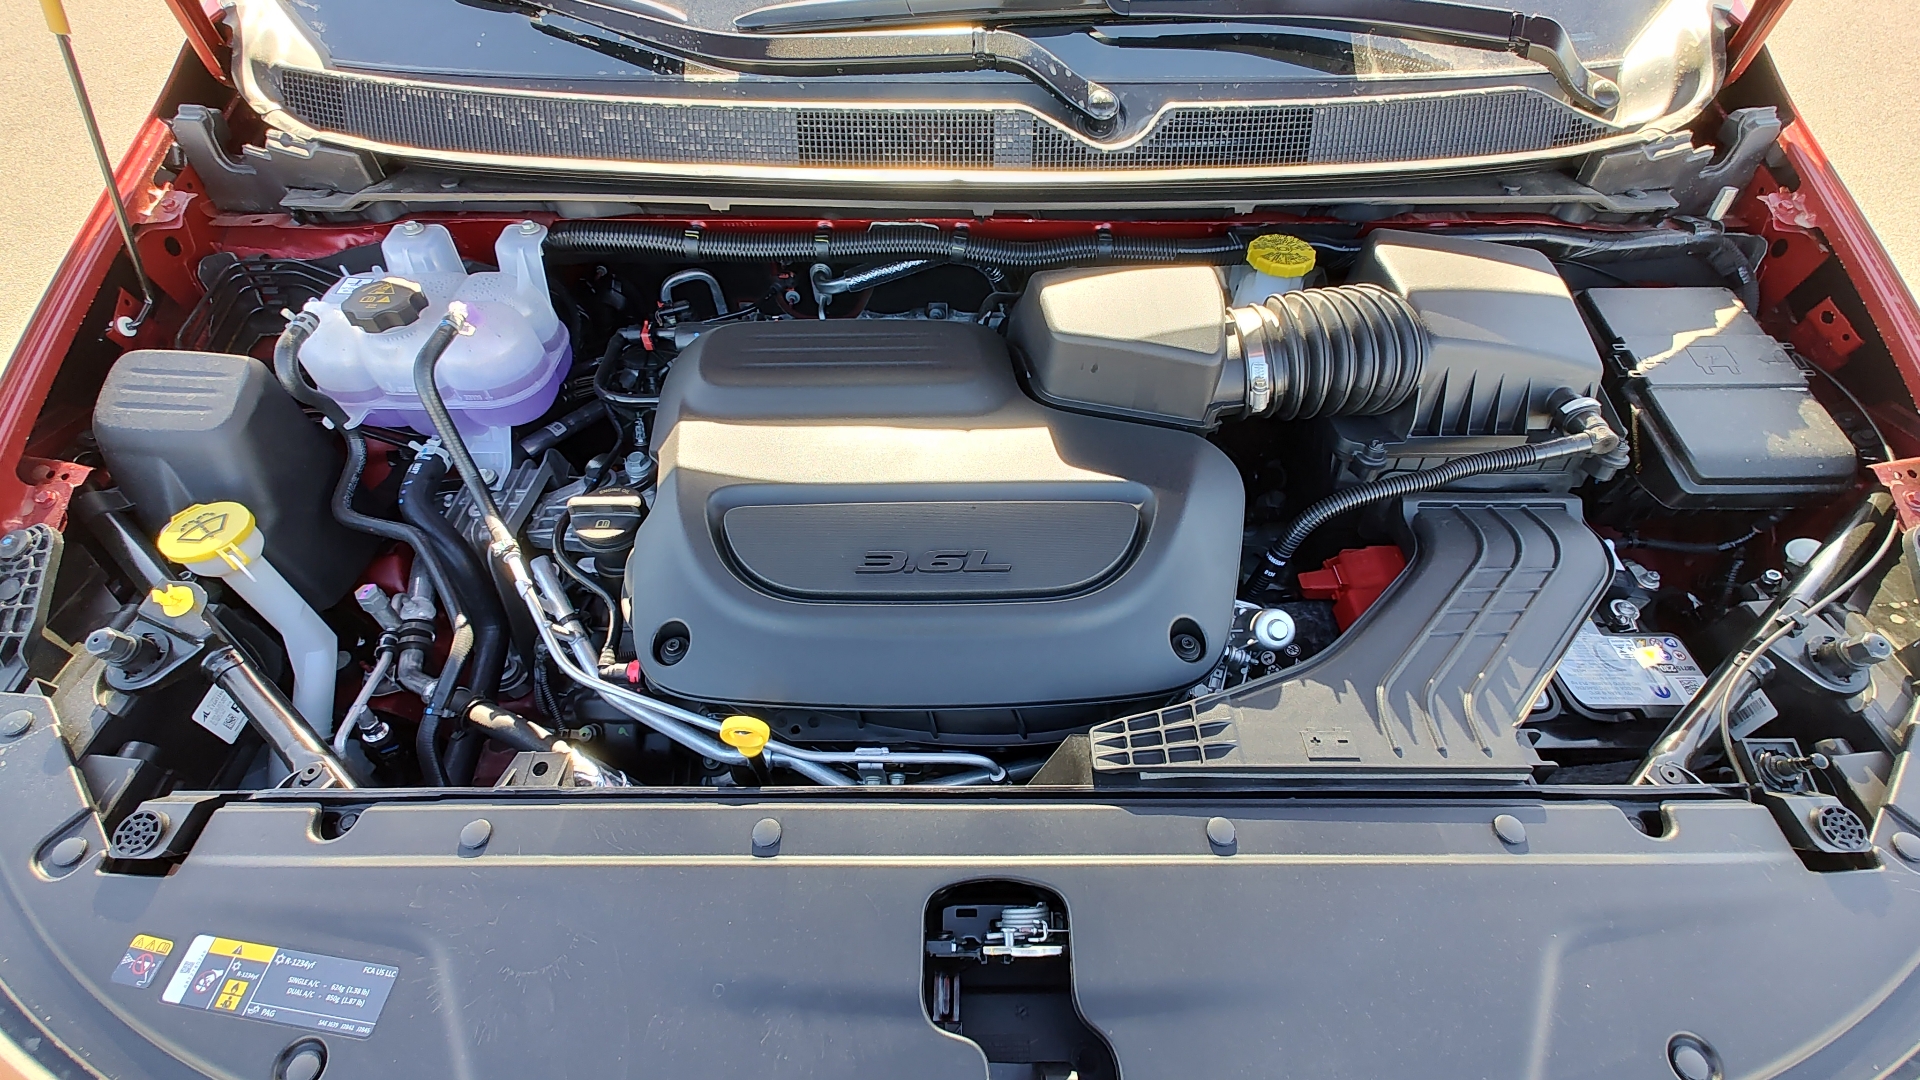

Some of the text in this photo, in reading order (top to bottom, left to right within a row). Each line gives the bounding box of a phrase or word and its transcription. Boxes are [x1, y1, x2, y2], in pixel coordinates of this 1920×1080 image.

[599, 487, 621, 495] ENGINE
[855, 549, 1012, 574] 3.6L
[284, 957, 317, 970] R-1234yf
[236, 970, 260, 980] R-1234yf
[363, 966, 397, 978] FCA US LLC
[288, 976, 308, 986] SINGLE
[308, 979, 321, 988] A/C
[330, 983, 346, 994] 624g
[346, 985, 362, 995] (1.38
[361, 988, 371, 997] lb)
[286, 987, 303, 996] DUAL
[302, 990, 316, 999] A/C
[325, 994, 341, 1004] 850g
[341, 996, 357, 1005] (1.87
[356, 999, 366, 1008] lb)
[261, 1008, 276, 1018] PAG
